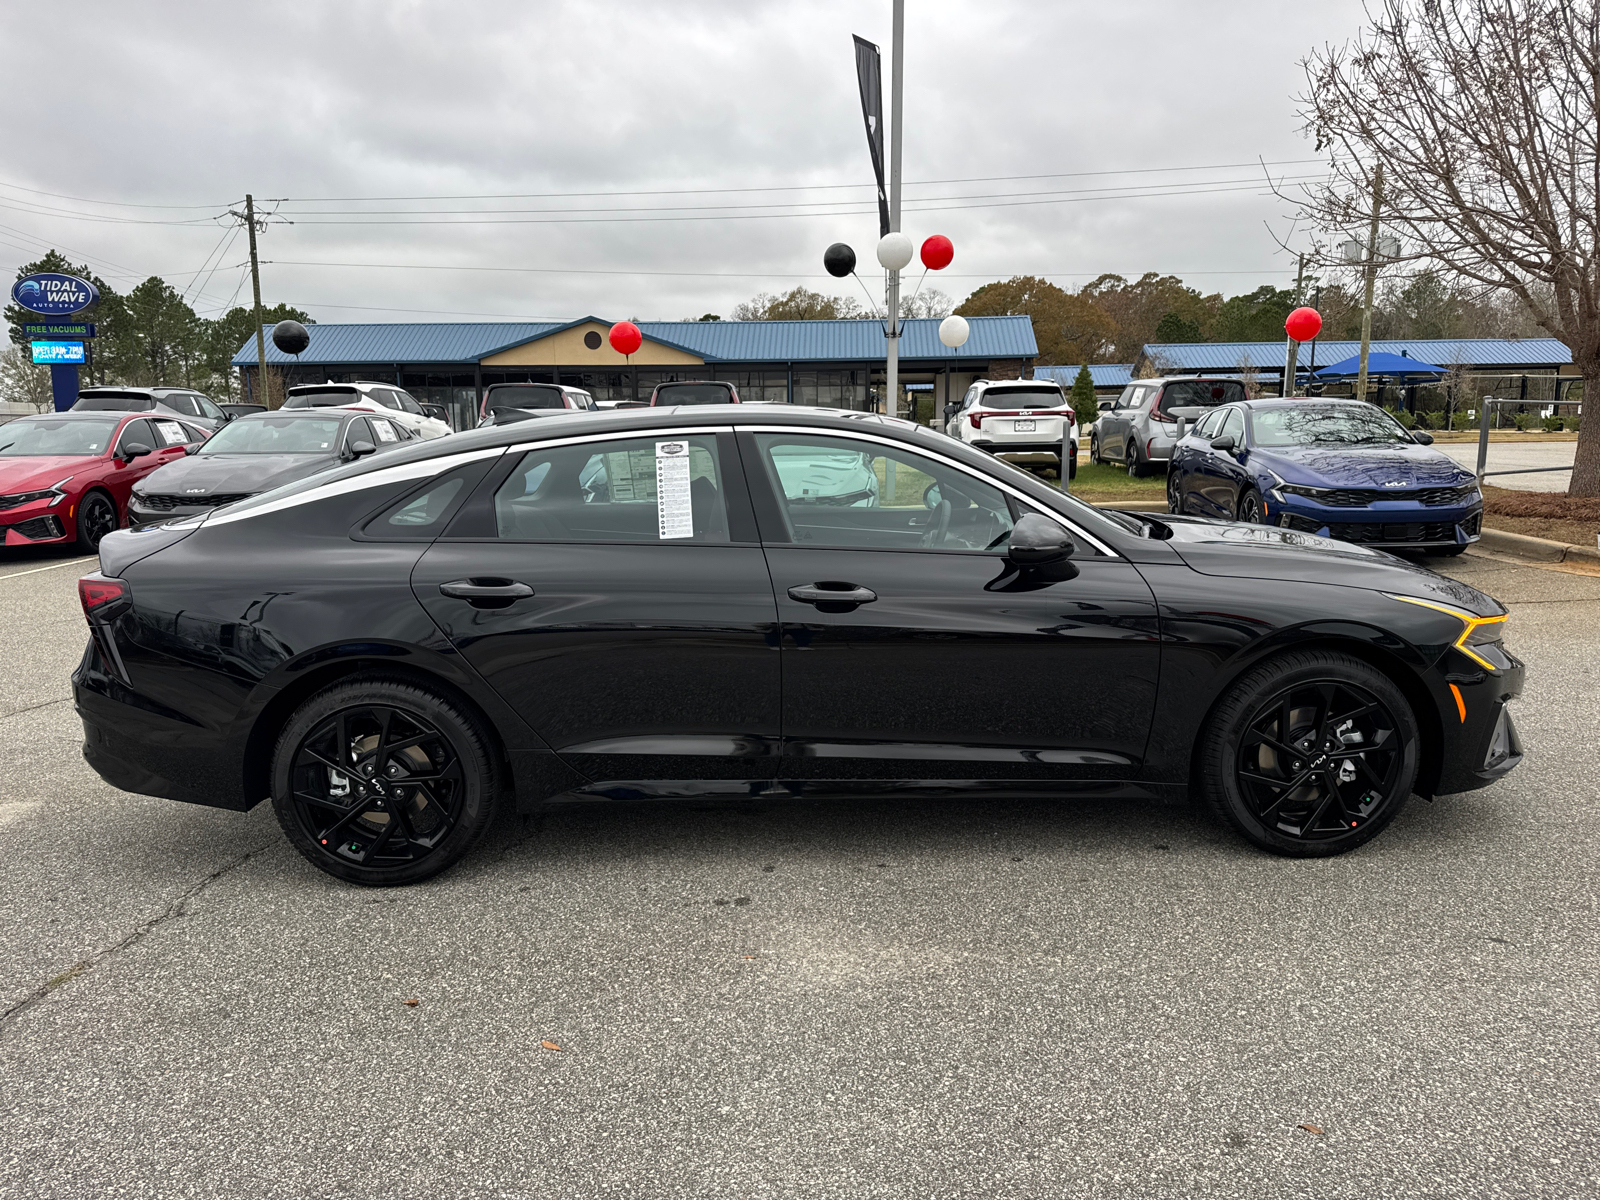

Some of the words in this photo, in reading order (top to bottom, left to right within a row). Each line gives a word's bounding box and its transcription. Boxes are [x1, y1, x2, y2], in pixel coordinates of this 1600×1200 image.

[40, 280, 77, 292] TIDAL
[47, 291, 86, 302] WAVE
[26, 325, 47, 333] FREE
[48, 325, 86, 333] VACUUMS
